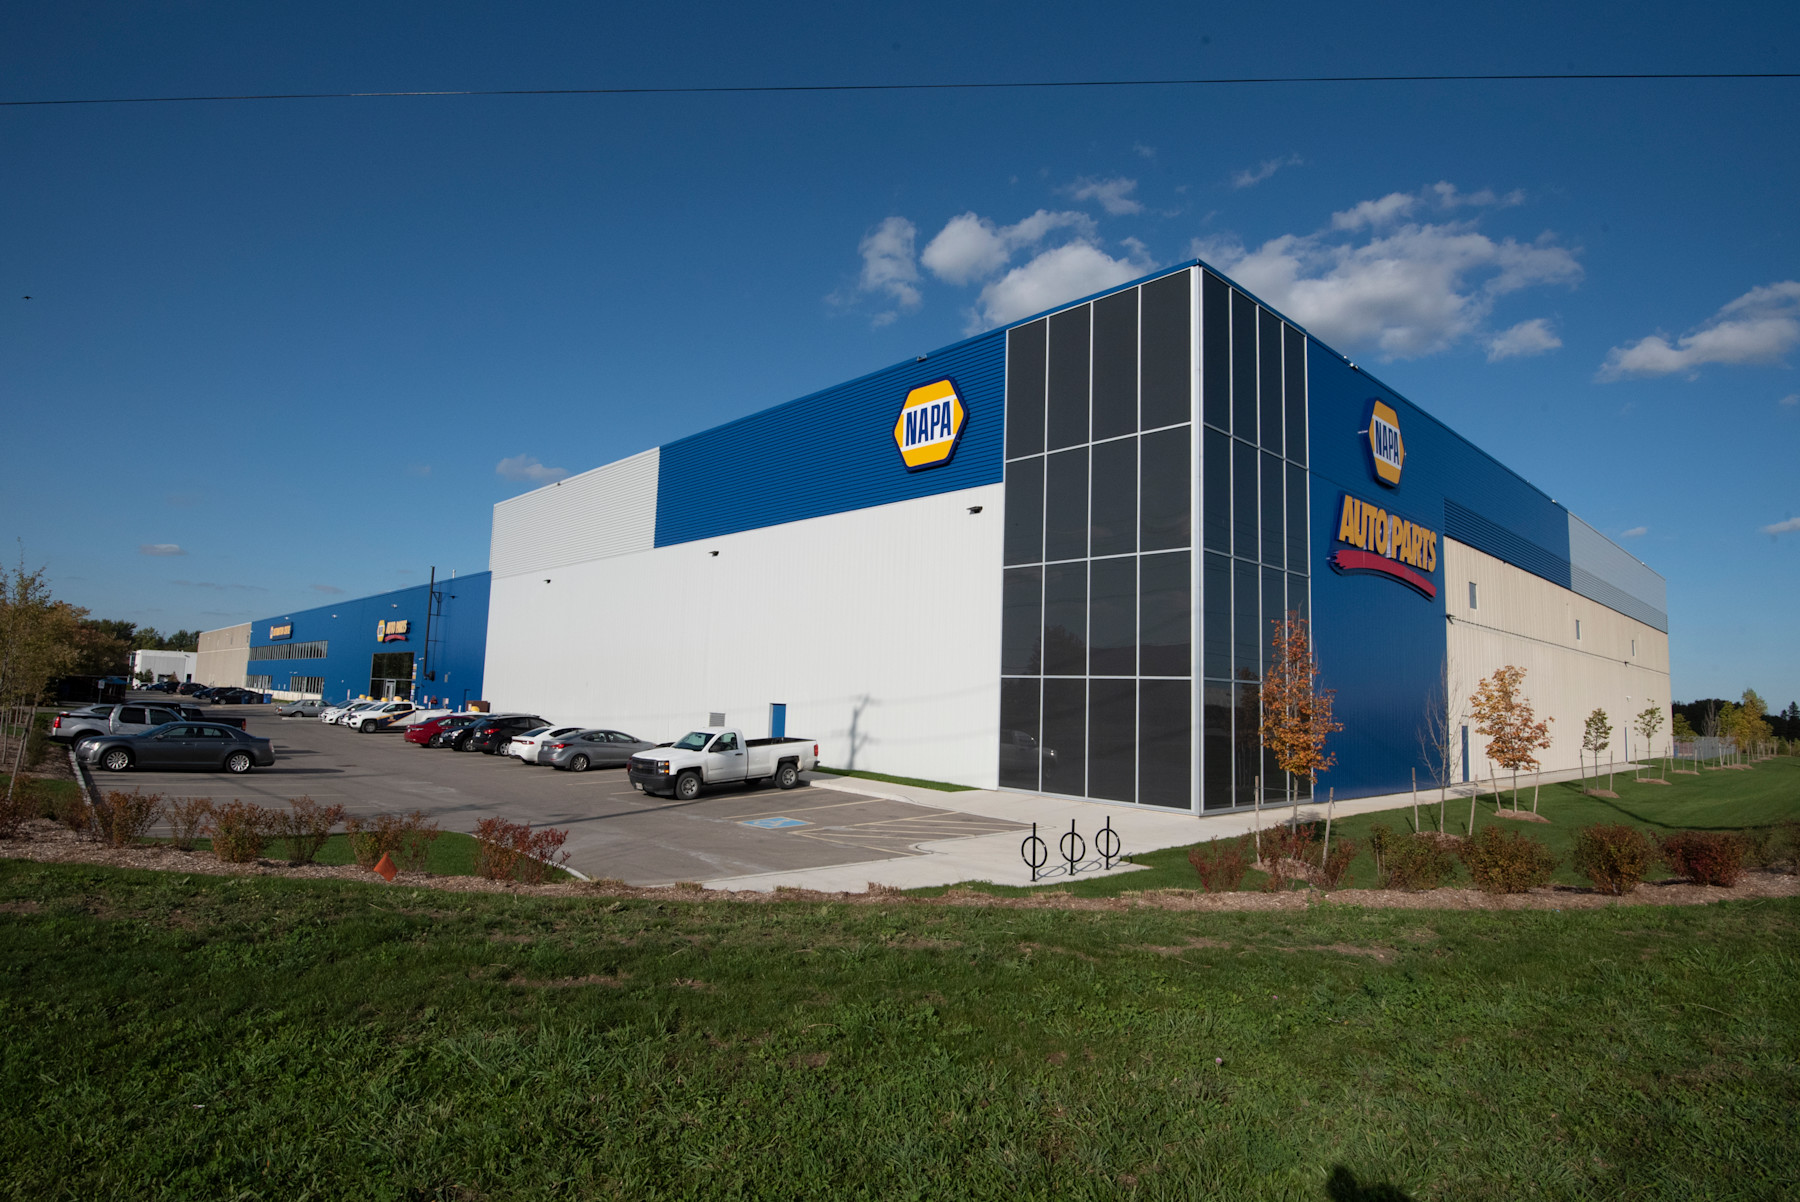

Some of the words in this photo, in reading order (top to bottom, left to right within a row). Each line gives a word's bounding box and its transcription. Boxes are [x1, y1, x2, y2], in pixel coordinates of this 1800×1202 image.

[905, 400, 952, 447] NAPA
[1375, 420, 1400, 466] NAPA
[1339, 494, 1388, 555] AUTO
[1391, 514, 1437, 572] PARTS
